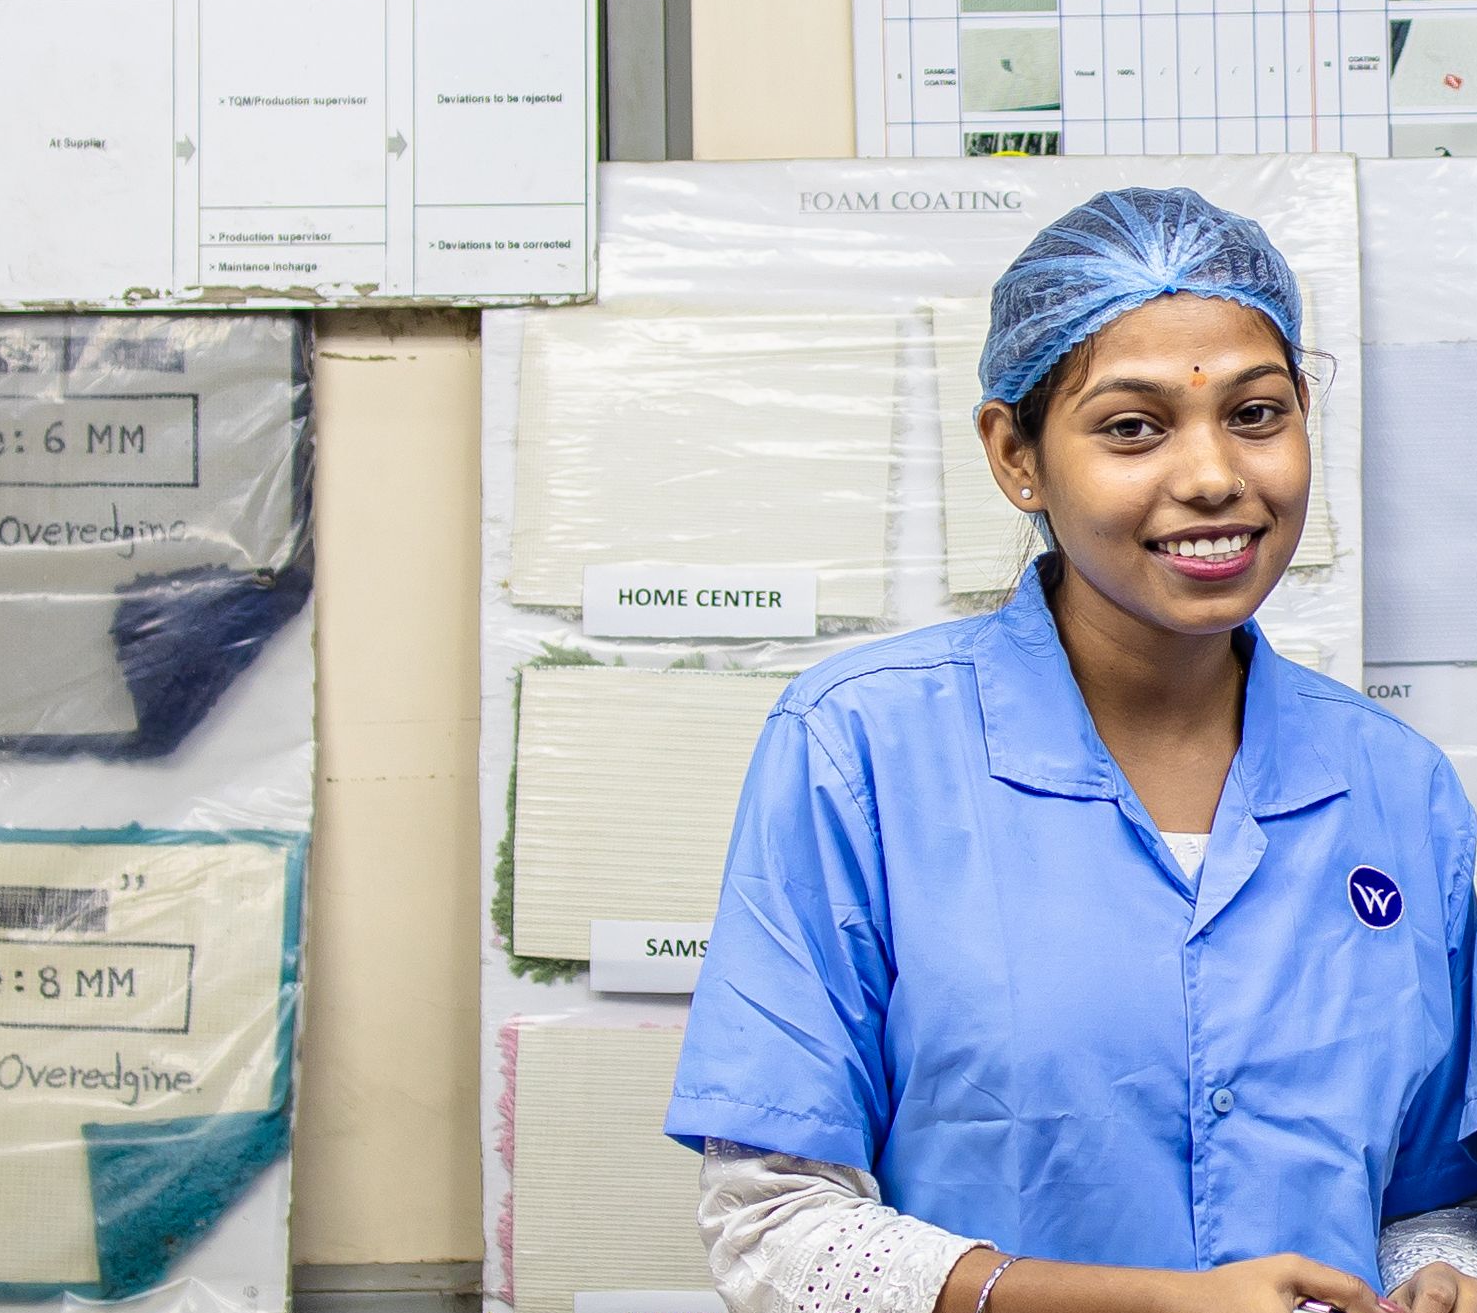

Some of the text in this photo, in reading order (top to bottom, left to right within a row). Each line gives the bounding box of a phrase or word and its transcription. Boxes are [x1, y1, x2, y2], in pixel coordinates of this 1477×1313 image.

[228, 95, 367, 108] TQM/Production supervisor
[437, 92, 562, 106] Deviations to be rejected
[49, 137, 106, 152] At Supplier
[799, 190, 1022, 211] FOAM COATING
[438, 238, 571, 250] Deviations to be corrected
[43, 421, 66, 454] 6
[86, 423, 145, 454] MM
[618, 587, 782, 609] HOME CENTER
[1367, 684, 1411, 700] COAT
[38, 966, 60, 999] 8
[75, 968, 135, 998] MM
